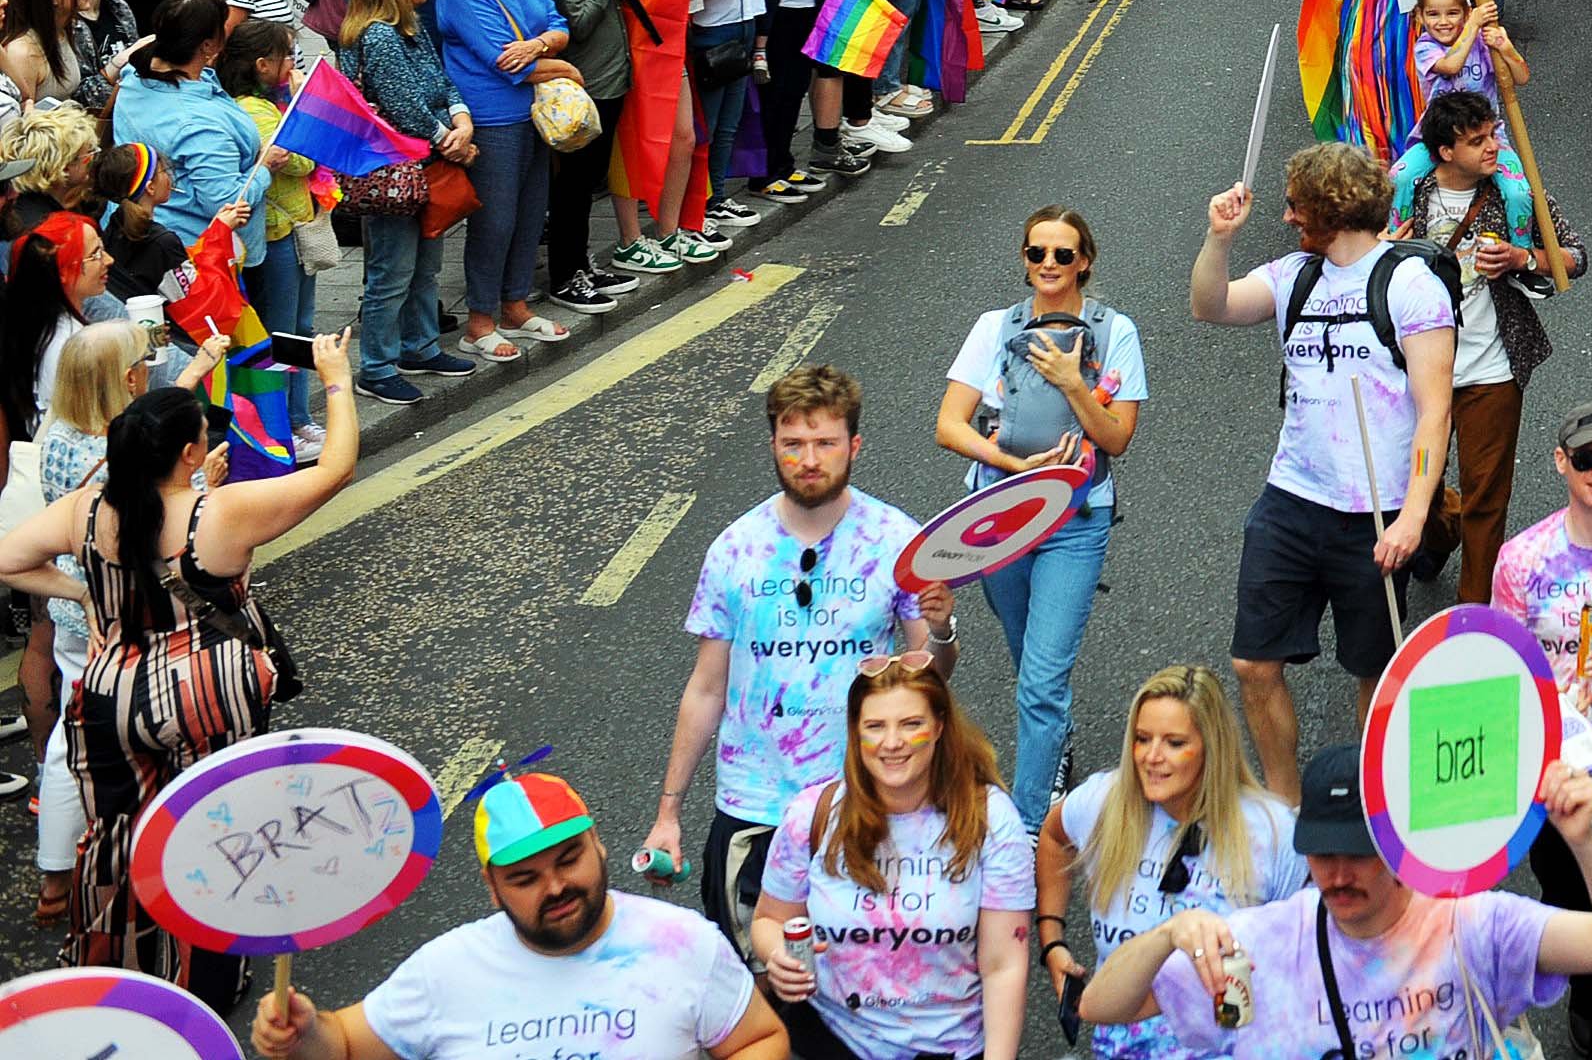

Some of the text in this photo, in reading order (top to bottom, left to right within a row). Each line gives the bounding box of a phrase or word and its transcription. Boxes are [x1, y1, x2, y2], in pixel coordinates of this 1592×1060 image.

[1284, 343, 1371, 363] veryone
[751, 571, 867, 602] Leaning
[777, 604, 840, 627] is for
[1561, 606, 1580, 628] is
[1436, 728, 1485, 784] brat
[852, 885, 936, 912] is for
[1126, 886, 1149, 915] is
[815, 924, 972, 951] everyone
[486, 1005, 637, 1047] Learning
[1387, 1025, 1433, 1058] for
